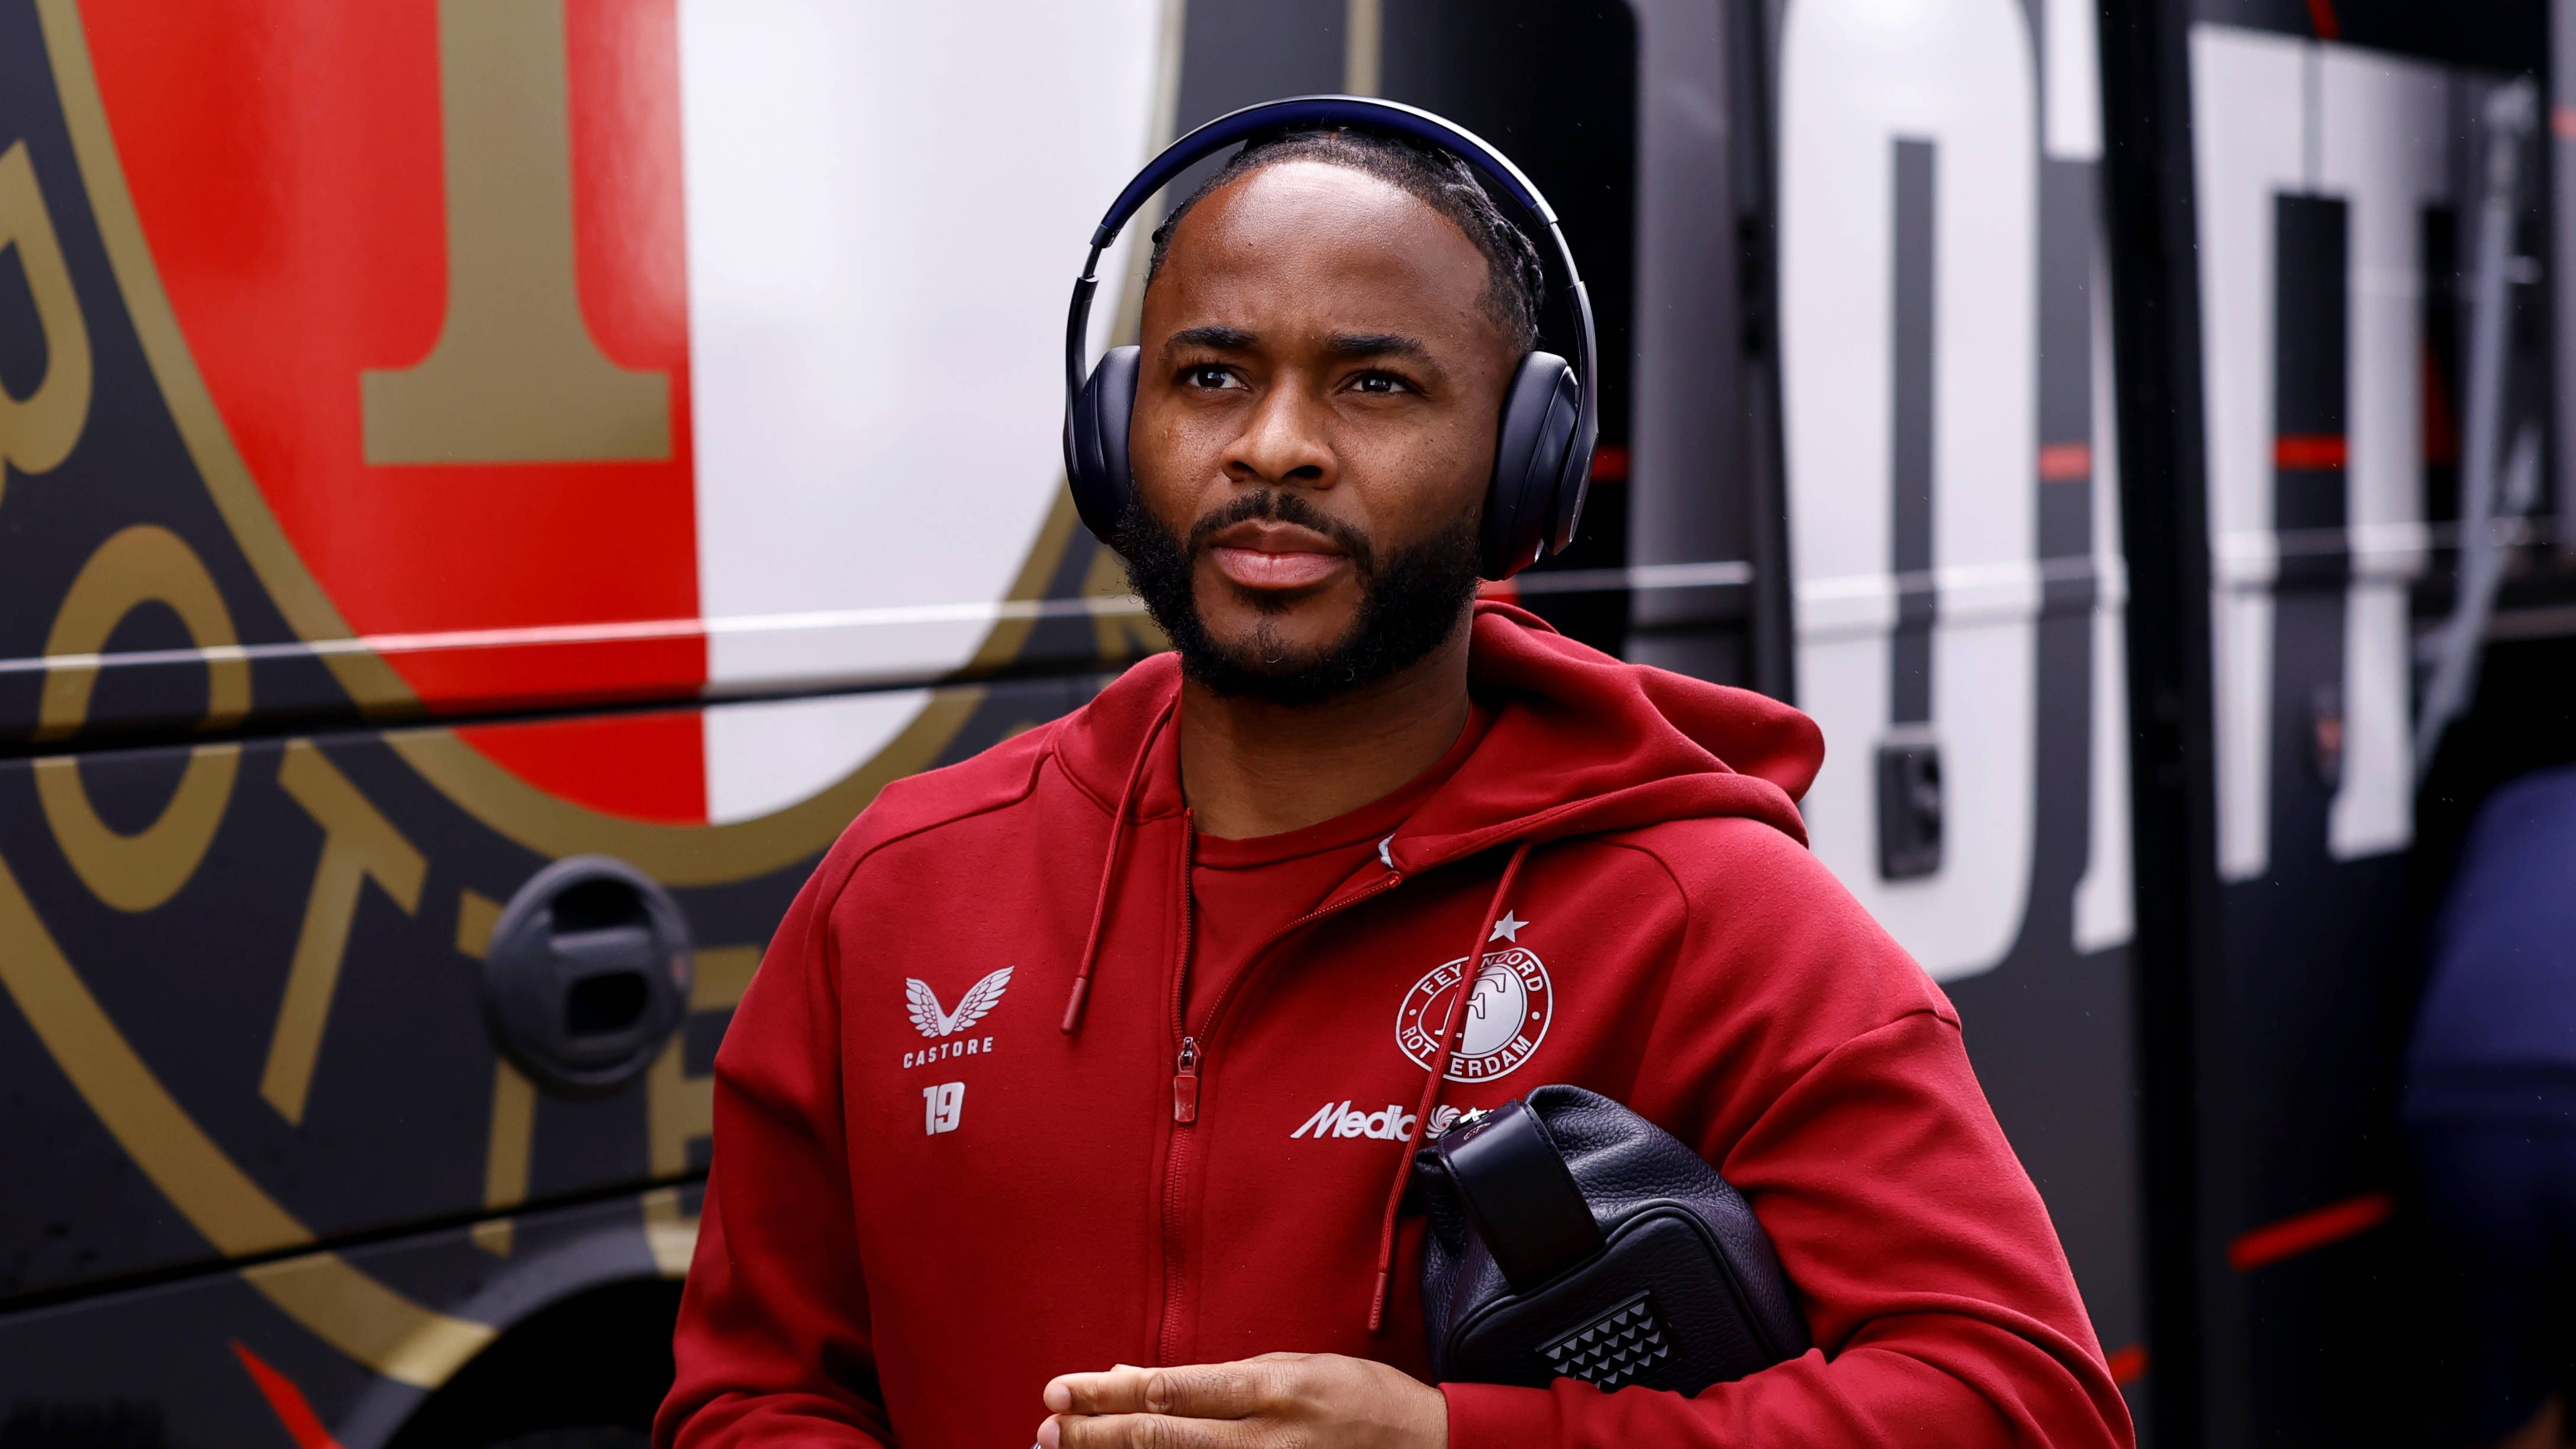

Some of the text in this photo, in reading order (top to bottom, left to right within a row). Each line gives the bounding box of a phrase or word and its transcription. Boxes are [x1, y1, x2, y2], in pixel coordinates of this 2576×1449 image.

[1420, 952, 1544, 996] FEYNOORD
[903, 1036, 994, 1069] CASTORE
[1401, 1025, 1532, 1077] ROTERDAM
[922, 1081, 966, 1136] 19
